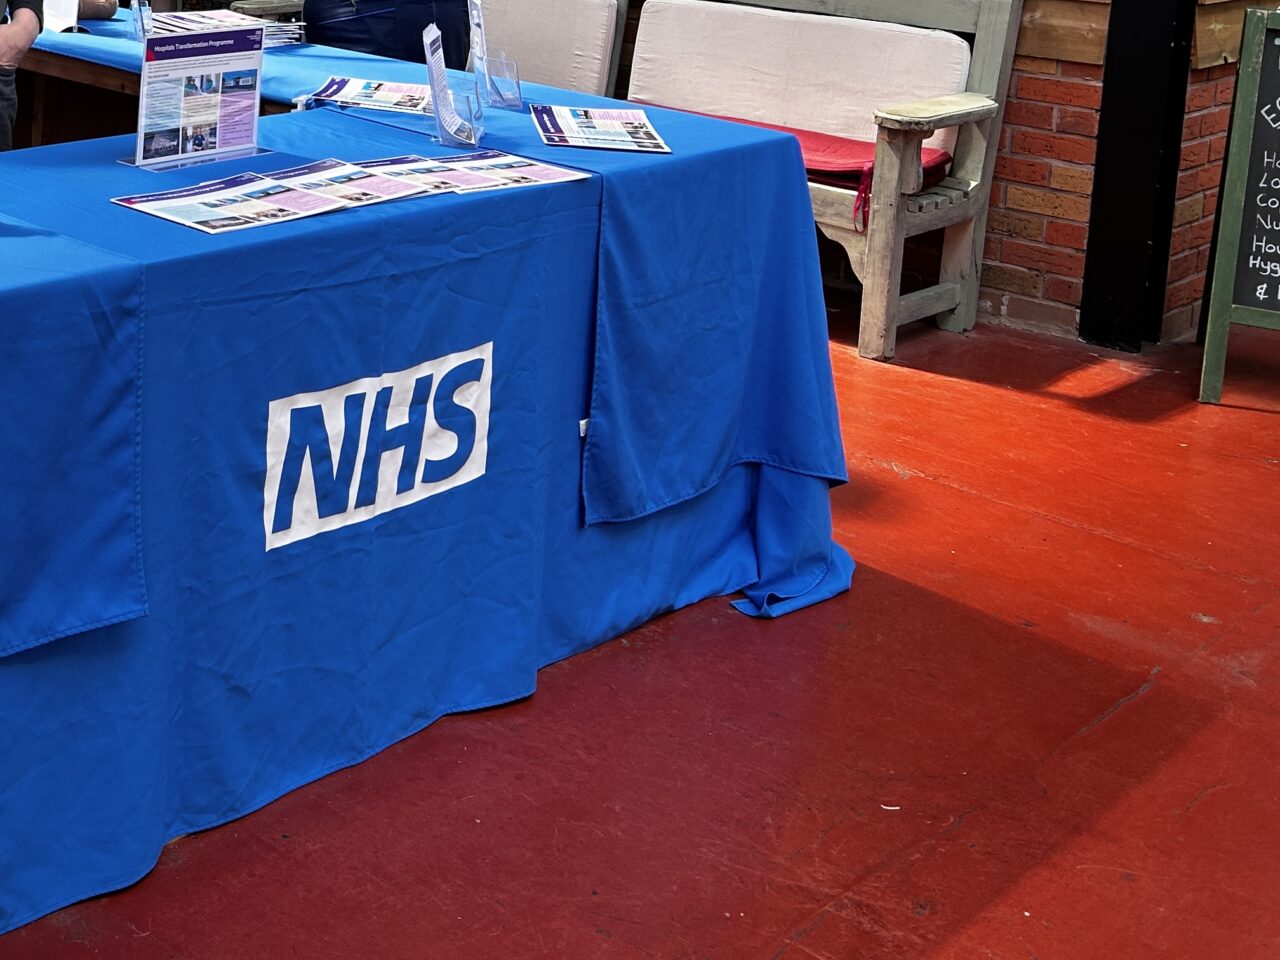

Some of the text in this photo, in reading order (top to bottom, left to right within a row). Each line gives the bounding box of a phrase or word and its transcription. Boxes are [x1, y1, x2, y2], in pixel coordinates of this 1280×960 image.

[154, 39, 234, 52] Hospitals Transformation Programme
[1256, 283, 1269, 301] &
[270, 356, 487, 536] NHS
